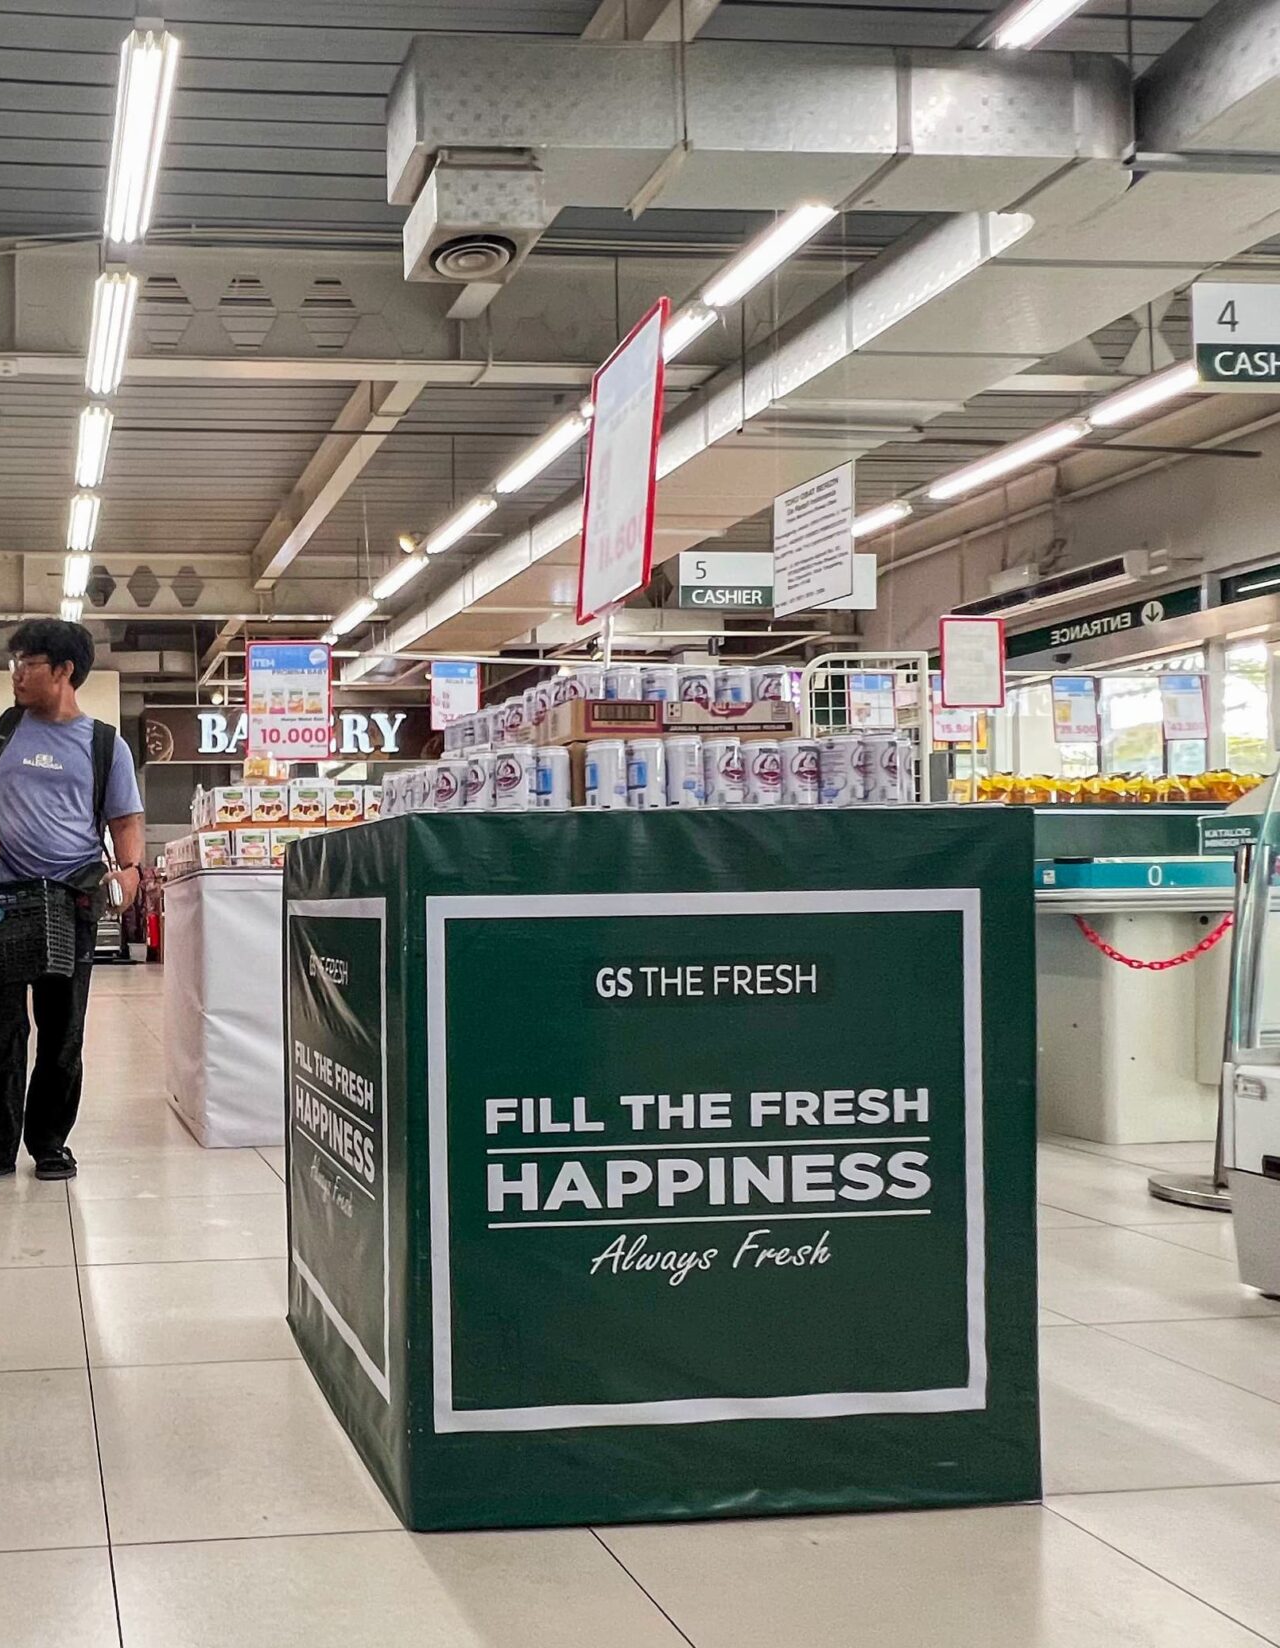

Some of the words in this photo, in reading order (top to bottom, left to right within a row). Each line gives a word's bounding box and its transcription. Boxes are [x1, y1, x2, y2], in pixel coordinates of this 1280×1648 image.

[1217, 299, 1239, 333] 4
[695, 560, 707, 580] 5
[691, 588, 762, 605] CASHIER
[197, 712, 407, 754] BARY
[260, 728, 327, 744] 10.000
[596, 966, 634, 998] GS
[639, 966, 704, 997] THE
[713, 964, 817, 996] FRESH
[295, 1040, 313, 1074] FILL
[314, 1050, 333, 1087] THE
[335, 1063, 374, 1114] FRESH
[485, 1096, 606, 1135] FILL
[620, 1092, 732, 1131] THE
[750, 1087, 930, 1127] FRESH
[296, 1084, 376, 1183] HAPPINESS
[487, 1150, 932, 1212] HAPPINESS
[590, 1233, 718, 1287] Always
[731, 1228, 832, 1270] Fresh
